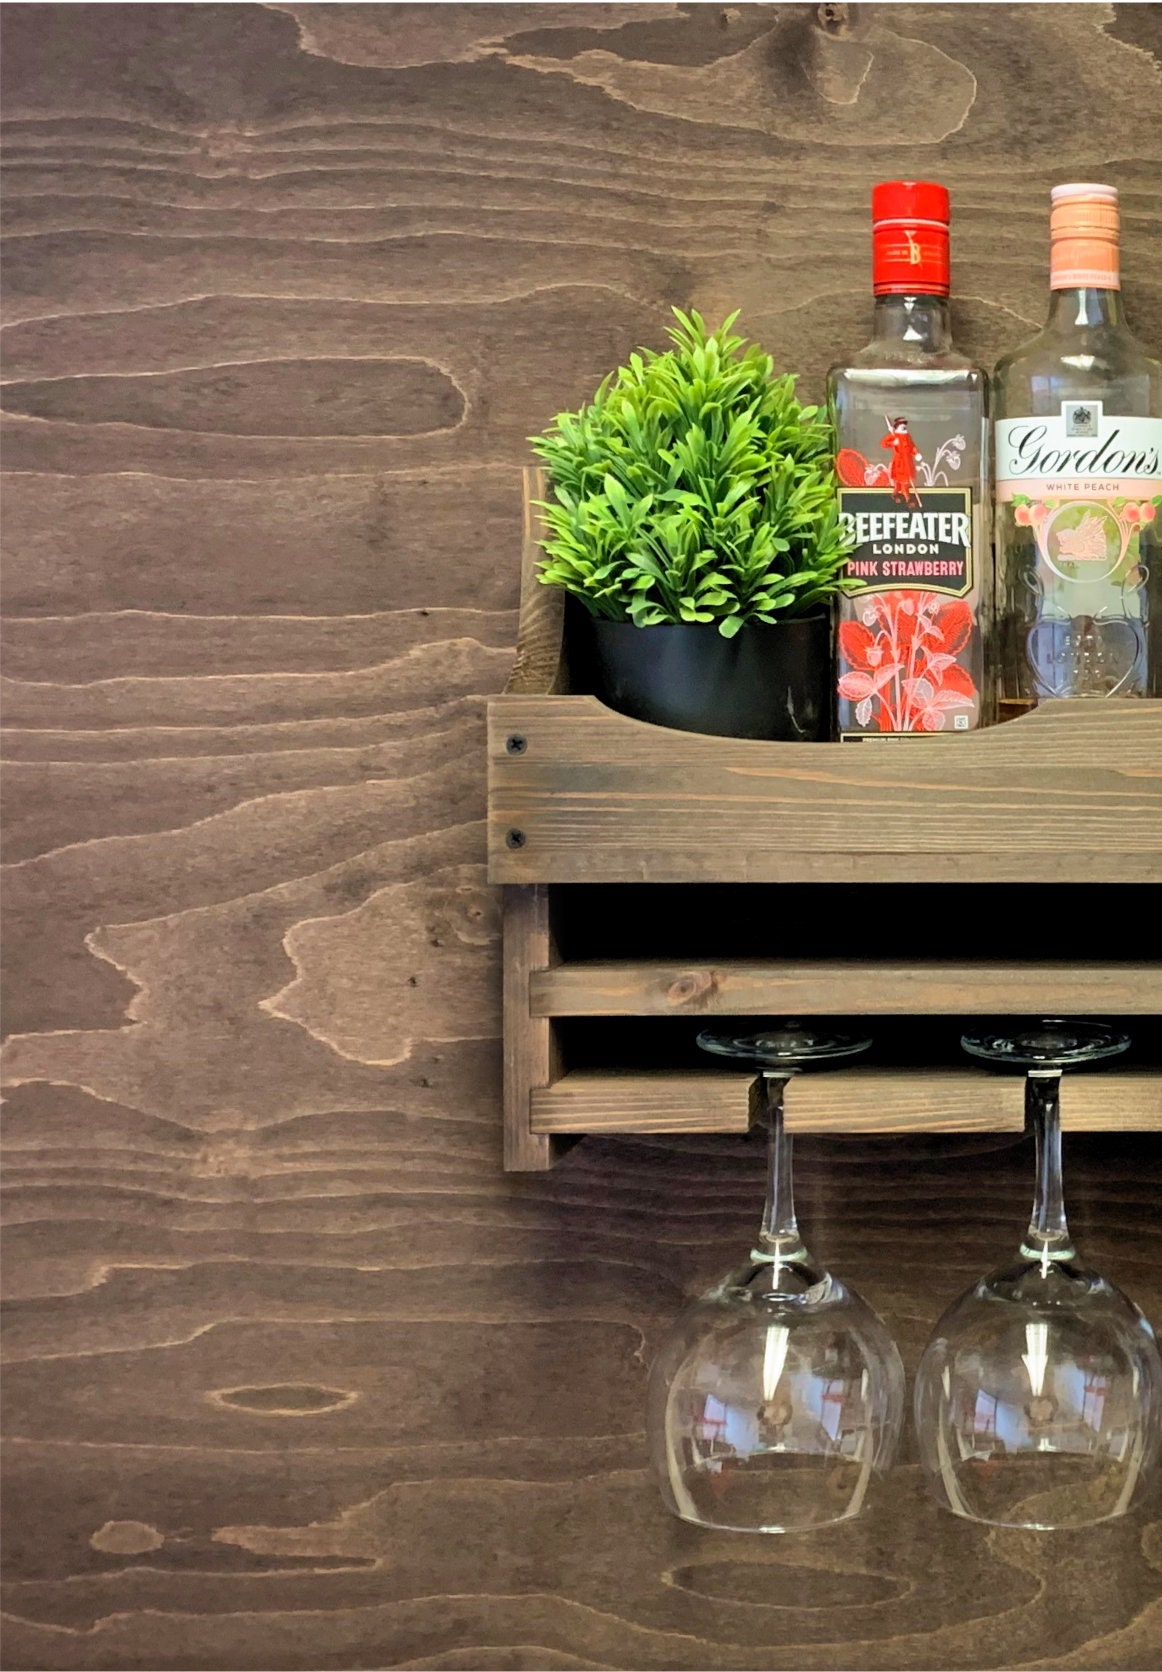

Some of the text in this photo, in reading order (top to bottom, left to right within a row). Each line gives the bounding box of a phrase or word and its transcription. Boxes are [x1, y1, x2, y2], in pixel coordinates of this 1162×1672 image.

[1008, 424, 1160, 476] Gordon's
[1046, 483, 1120, 491] WHITE PEACH
[872, 543, 940, 555] LONDON
[847, 560, 964, 576] PINK STRAWBERRY
